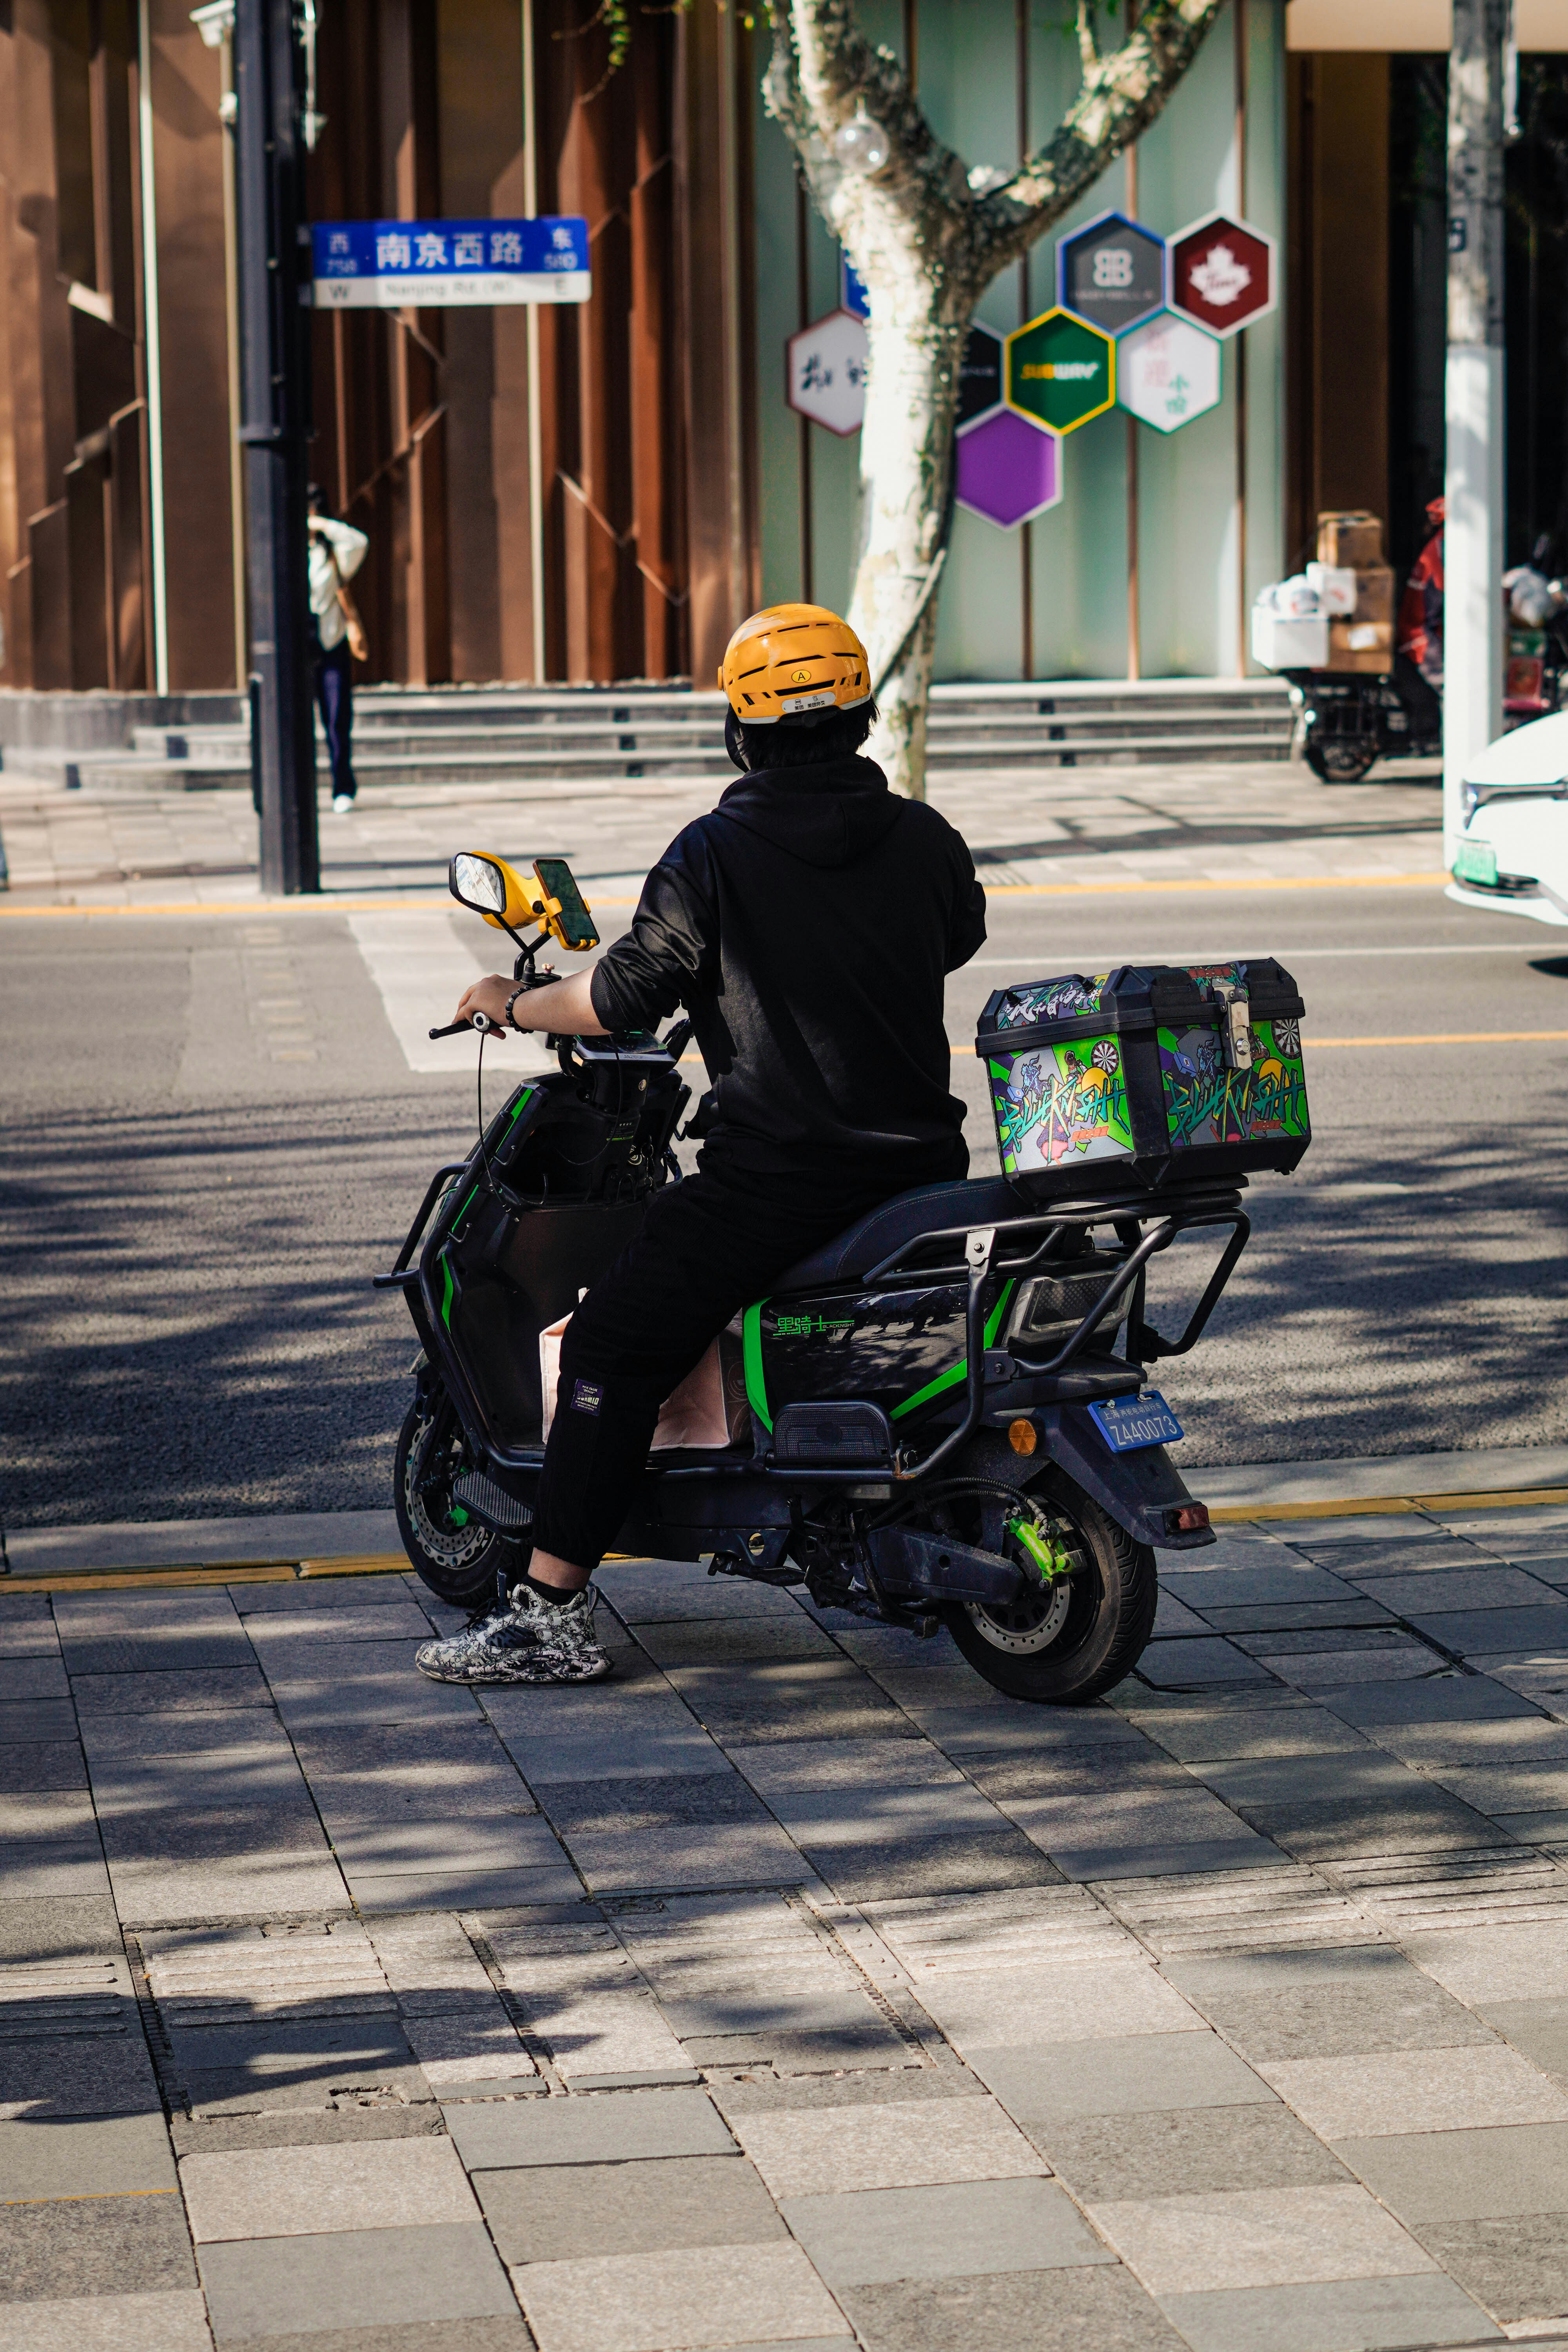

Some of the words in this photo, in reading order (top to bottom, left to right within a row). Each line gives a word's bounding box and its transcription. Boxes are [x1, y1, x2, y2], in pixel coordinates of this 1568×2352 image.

[329, 232, 349, 254] 西
[552, 226, 573, 250] 东
[376, 231, 523, 270] 南京西路
[328, 283, 351, 299] W
[386, 282, 446, 298] Nanjing
[554, 276, 568, 295] E
[1020, 363, 1099, 380] SUBWAY
[798, 672, 806, 681] A
[773, 1316, 855, 1336] 黑骑士
[1103, 1410, 1120, 1420] 上海
[1119, 1402, 1163, 1417] 两轮电动自行车
[1109, 1415, 1177, 1446] Z440073
